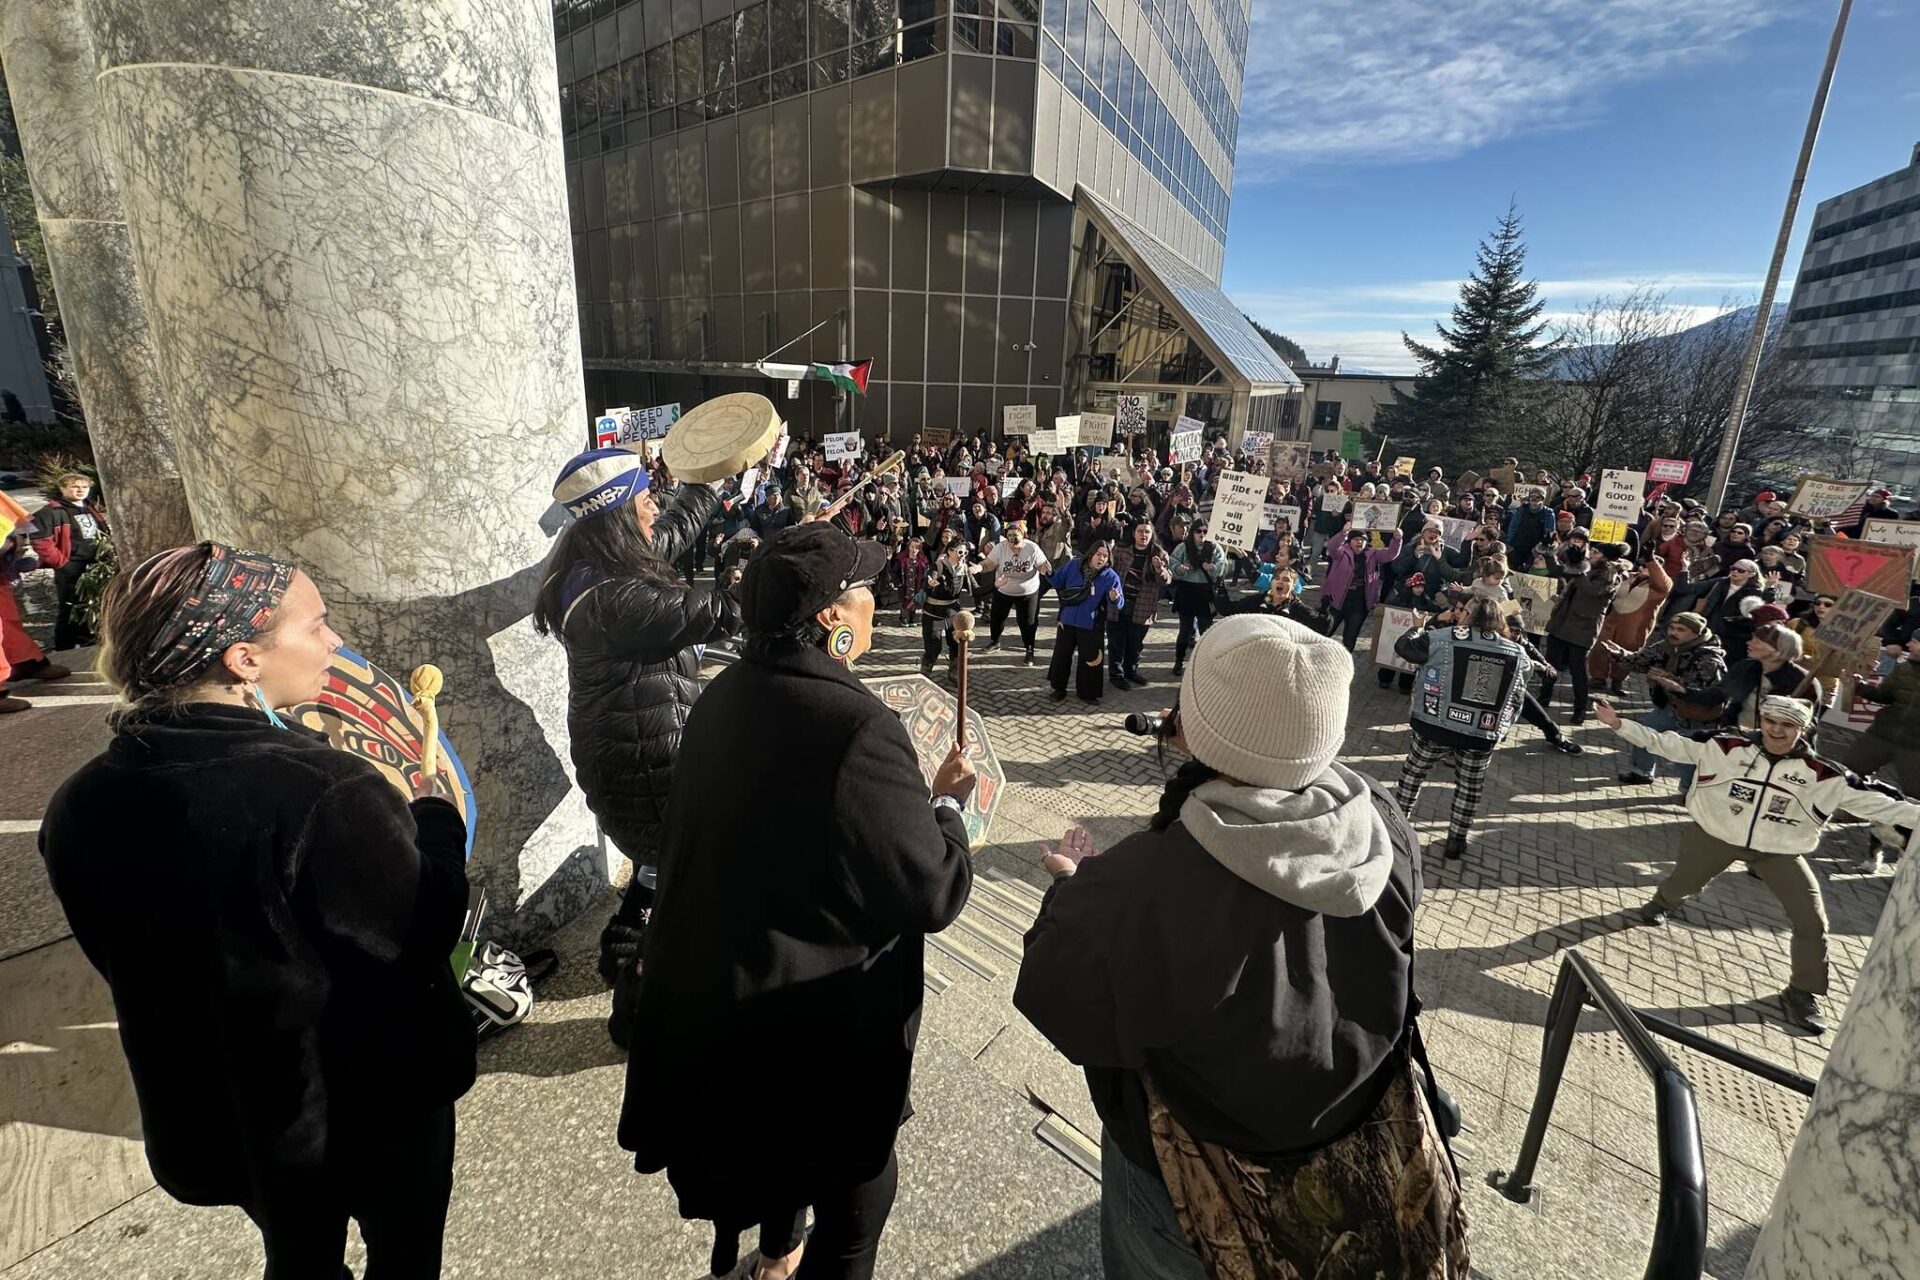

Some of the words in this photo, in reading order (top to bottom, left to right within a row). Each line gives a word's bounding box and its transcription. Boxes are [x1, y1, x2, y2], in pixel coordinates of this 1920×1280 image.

[621, 407, 663, 424] GREED
[1008, 412, 1032, 420] FIGHT
[622, 419, 656, 434] OVER
[1084, 420, 1108, 430] FIGHT
[623, 424, 672, 445] PEOPLE
[1222, 472, 1245, 482] WHAT
[1603, 471, 1620, 479] A:
[1231, 484, 1251, 495] SIDE
[1612, 481, 1633, 490] That
[1220, 492, 1257, 512] History
[1605, 491, 1635, 502] GOOD
[1608, 503, 1628, 511] does
[1797, 504, 1831, 515] LAND
[1226, 511, 1243, 521] will
[1222, 520, 1243, 532] YOU
[1214, 533, 1225, 542] be
[1226, 538, 1243, 546] on?
[1391, 611, 1410, 627] WE
[1481, 655, 1506, 665] DIVISION
[1450, 710, 1470, 721] NIN
